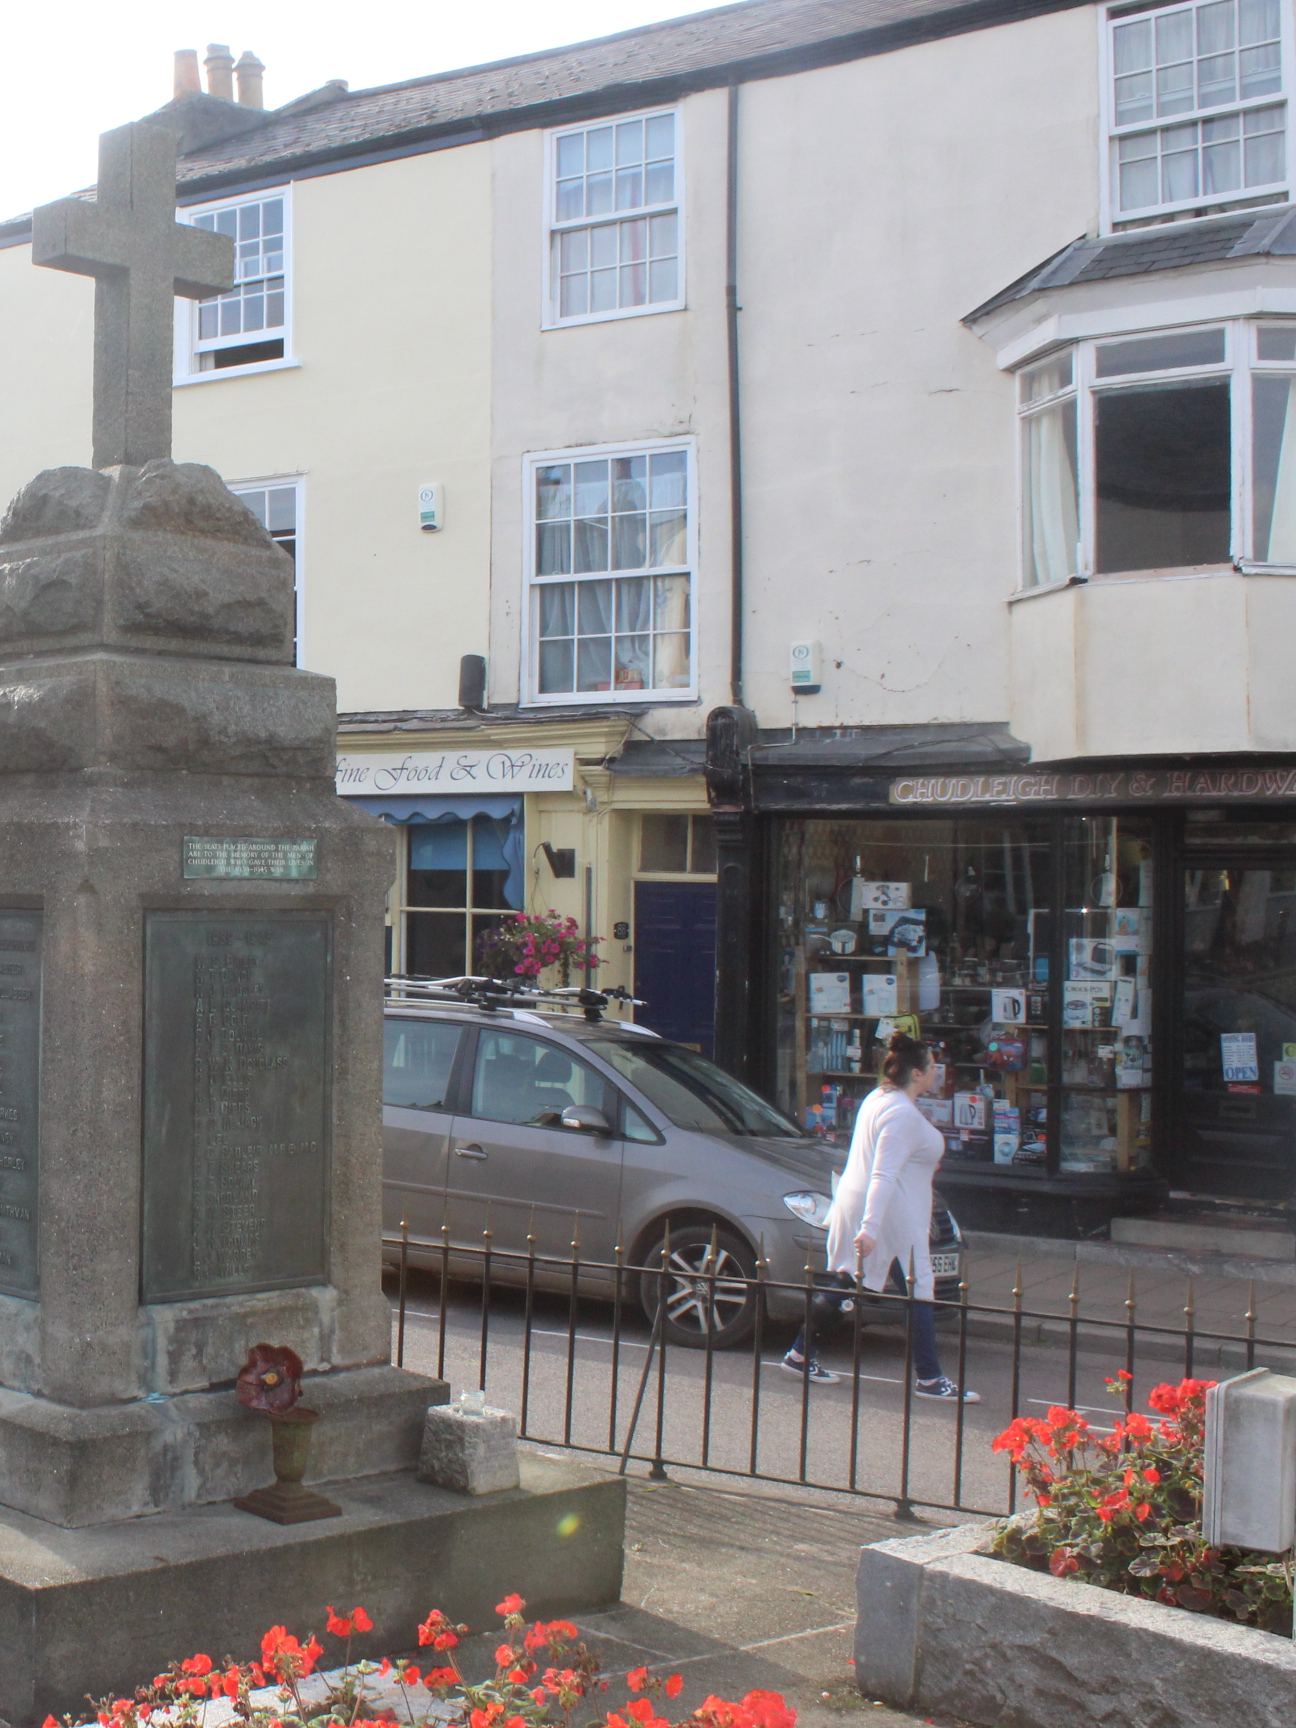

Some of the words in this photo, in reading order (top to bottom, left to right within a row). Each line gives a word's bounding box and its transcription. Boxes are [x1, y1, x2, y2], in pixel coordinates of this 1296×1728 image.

[374, 755, 446, 790] Food
[450, 755, 481, 780] &
[486, 753, 568, 780] Wines
[894, 775, 1058, 802] CHUDLEIGH
[1069, 772, 1126, 798] DIY
[1129, 770, 1154, 796] &
[1225, 1066, 1258, 1080] OPEN
